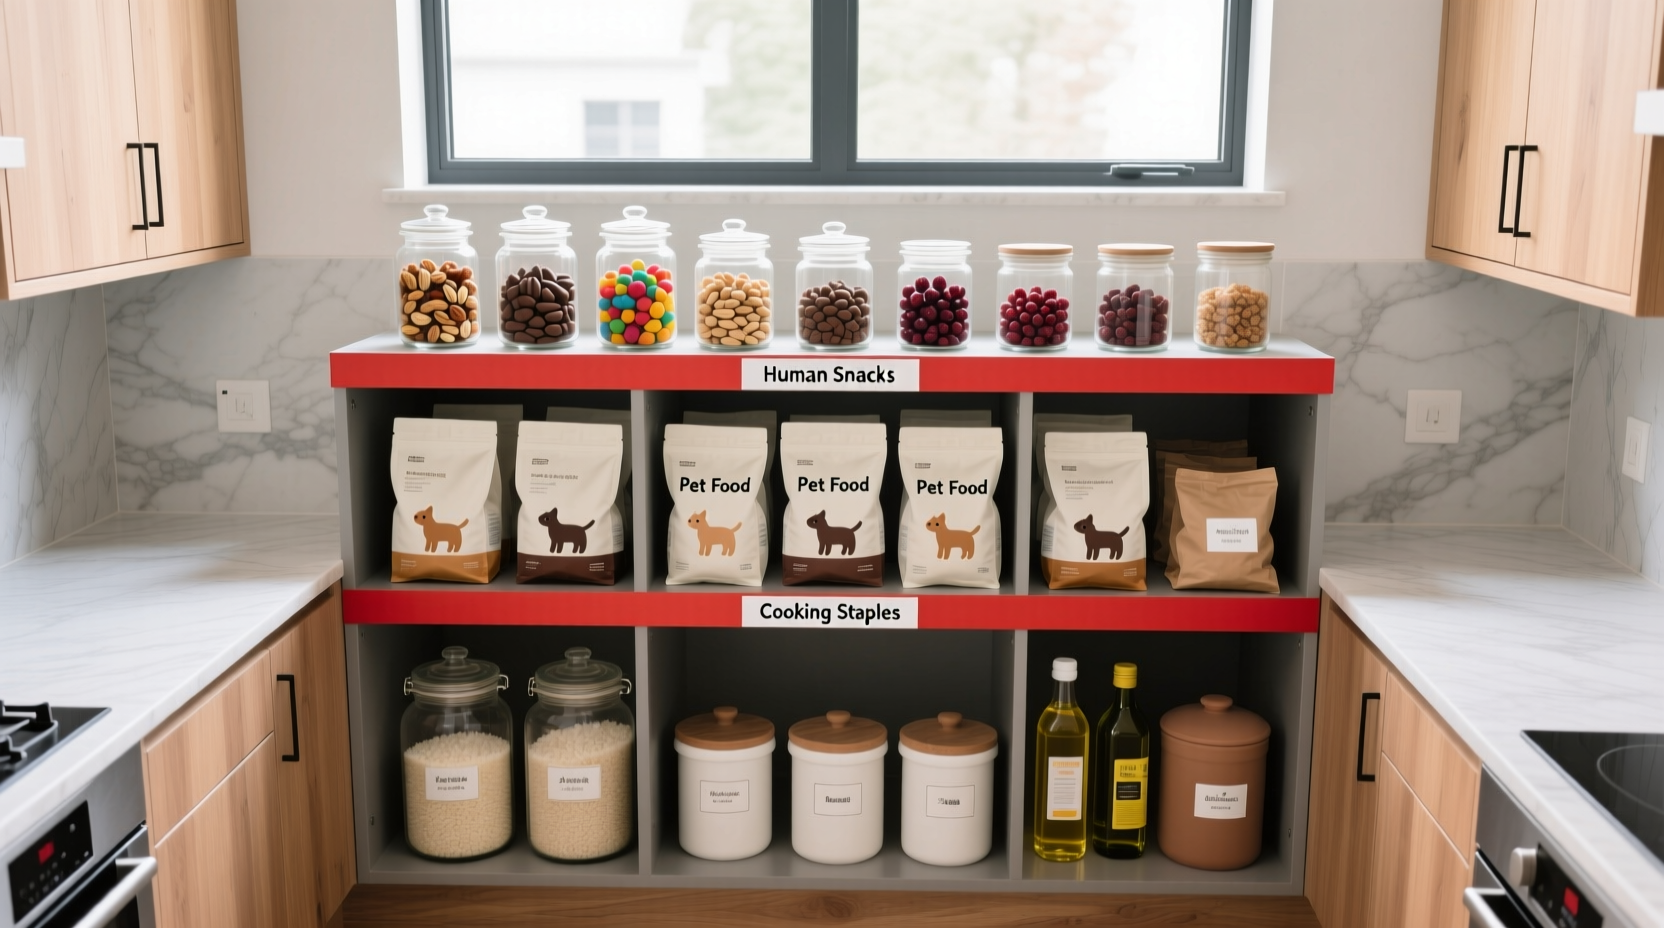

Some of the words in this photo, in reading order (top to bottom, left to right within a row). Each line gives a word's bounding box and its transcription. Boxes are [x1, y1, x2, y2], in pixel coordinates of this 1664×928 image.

[764, 365, 828, 383] Human
[833, 365, 895, 384] Snacks
[679, 477, 707, 493] Pet
[711, 477, 751, 493] Food
[797, 476, 825, 492] Pet
[830, 476, 870, 492] Food
[916, 479, 944, 494] Pet
[949, 479, 988, 495] Food
[759, 603, 832, 625] Cooking
[837, 602, 901, 625] Staples
